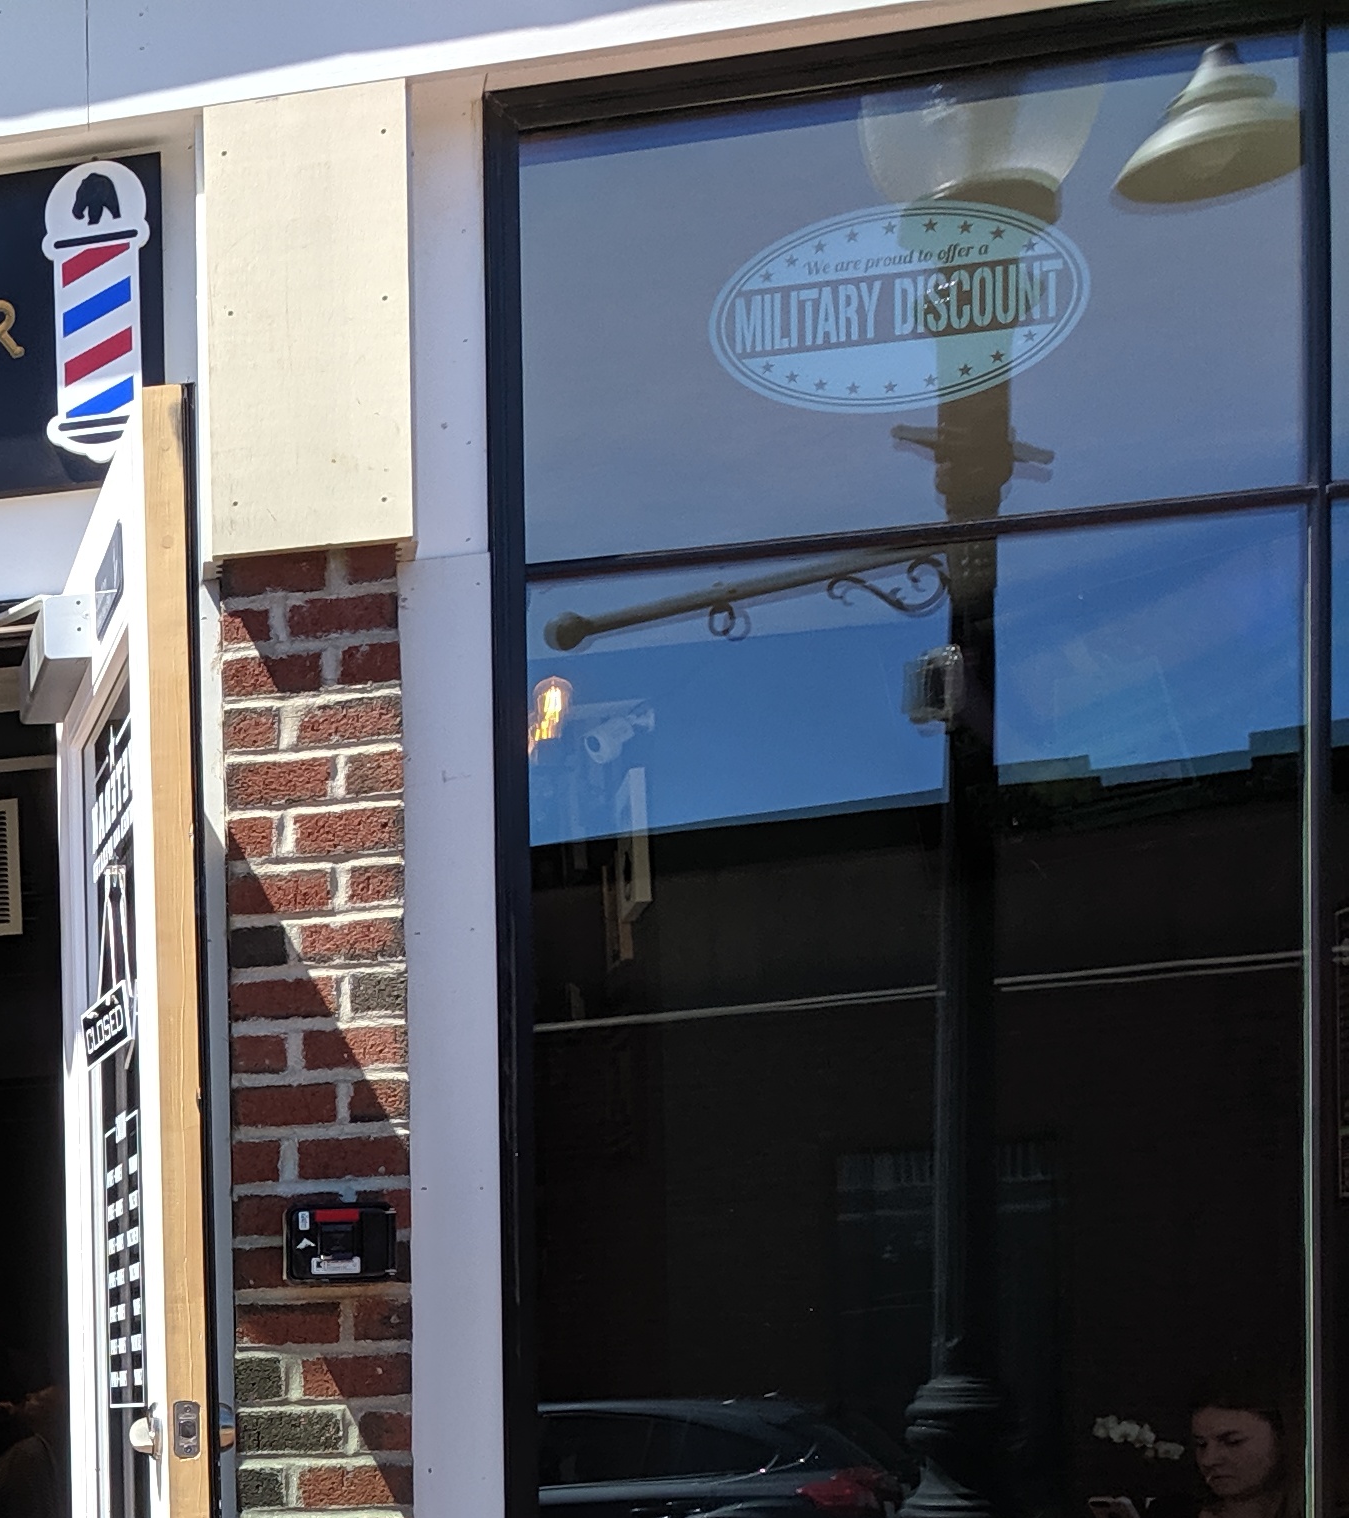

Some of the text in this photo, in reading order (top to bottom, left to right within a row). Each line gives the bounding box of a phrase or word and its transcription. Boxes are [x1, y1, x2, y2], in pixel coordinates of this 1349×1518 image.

[803, 243, 990, 276] We are proud to offer a
[734, 258, 1063, 354] MILITARY DISCOUNT
[86, 1005, 124, 1055] CLOSED
